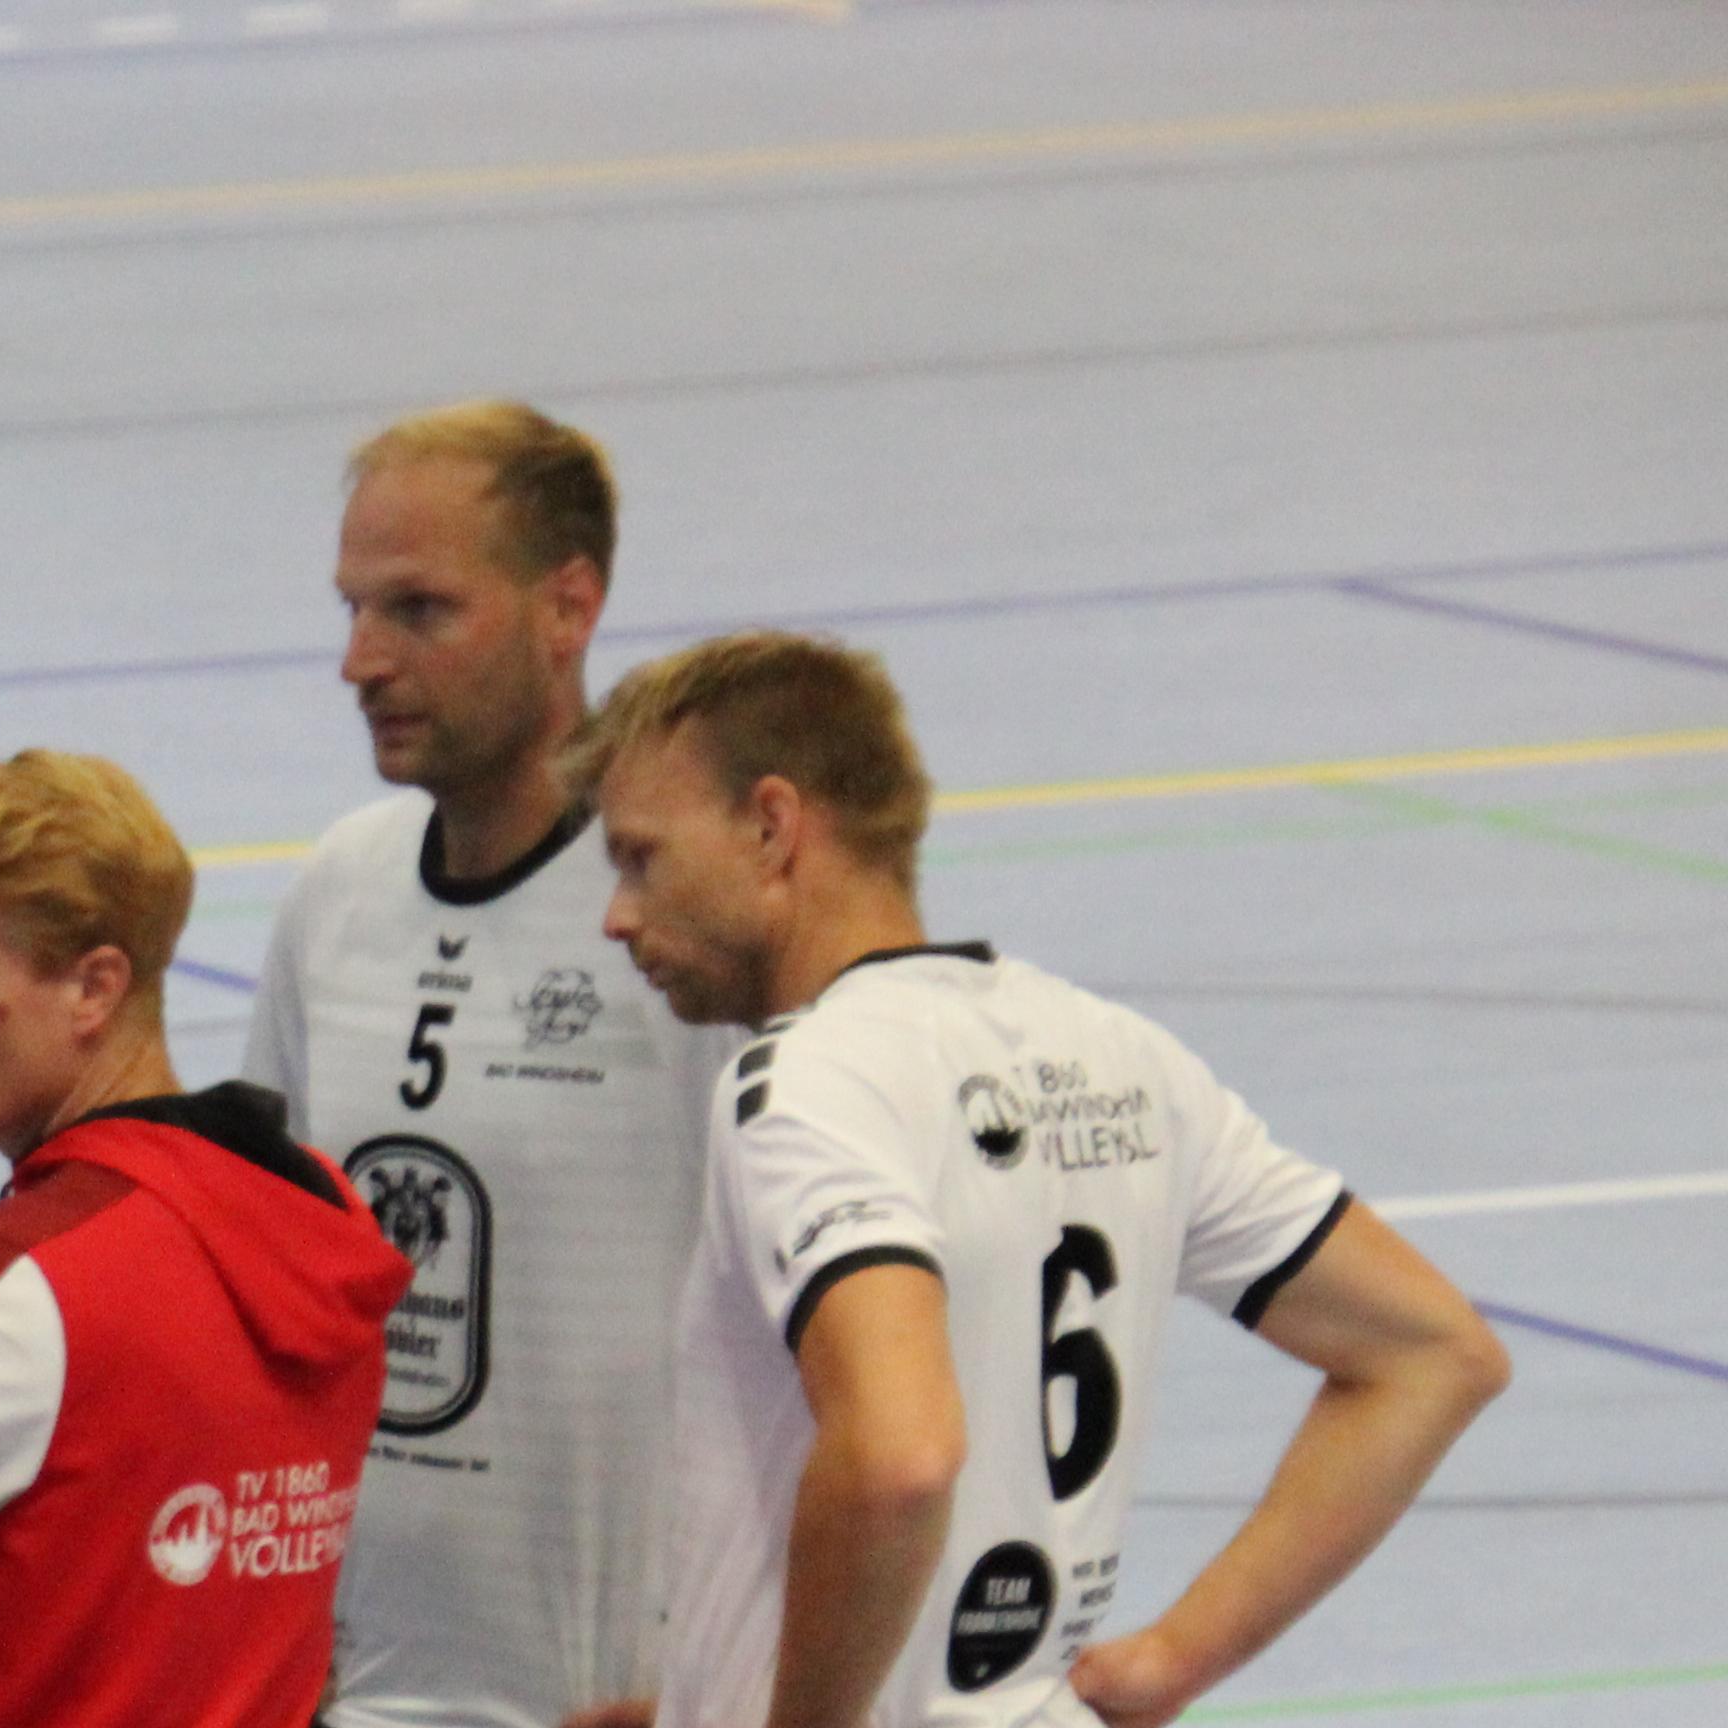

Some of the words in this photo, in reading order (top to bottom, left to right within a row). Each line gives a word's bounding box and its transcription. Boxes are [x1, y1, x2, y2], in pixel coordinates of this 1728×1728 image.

[400, 1003, 456, 1111] 5
[1042, 1223, 1123, 1502] 6
[237, 1470, 268, 1501] TV
[273, 1461, 331, 1498] 1860
[231, 1503, 281, 1538] BAD
[986, 1576, 1032, 1606] TEAM
